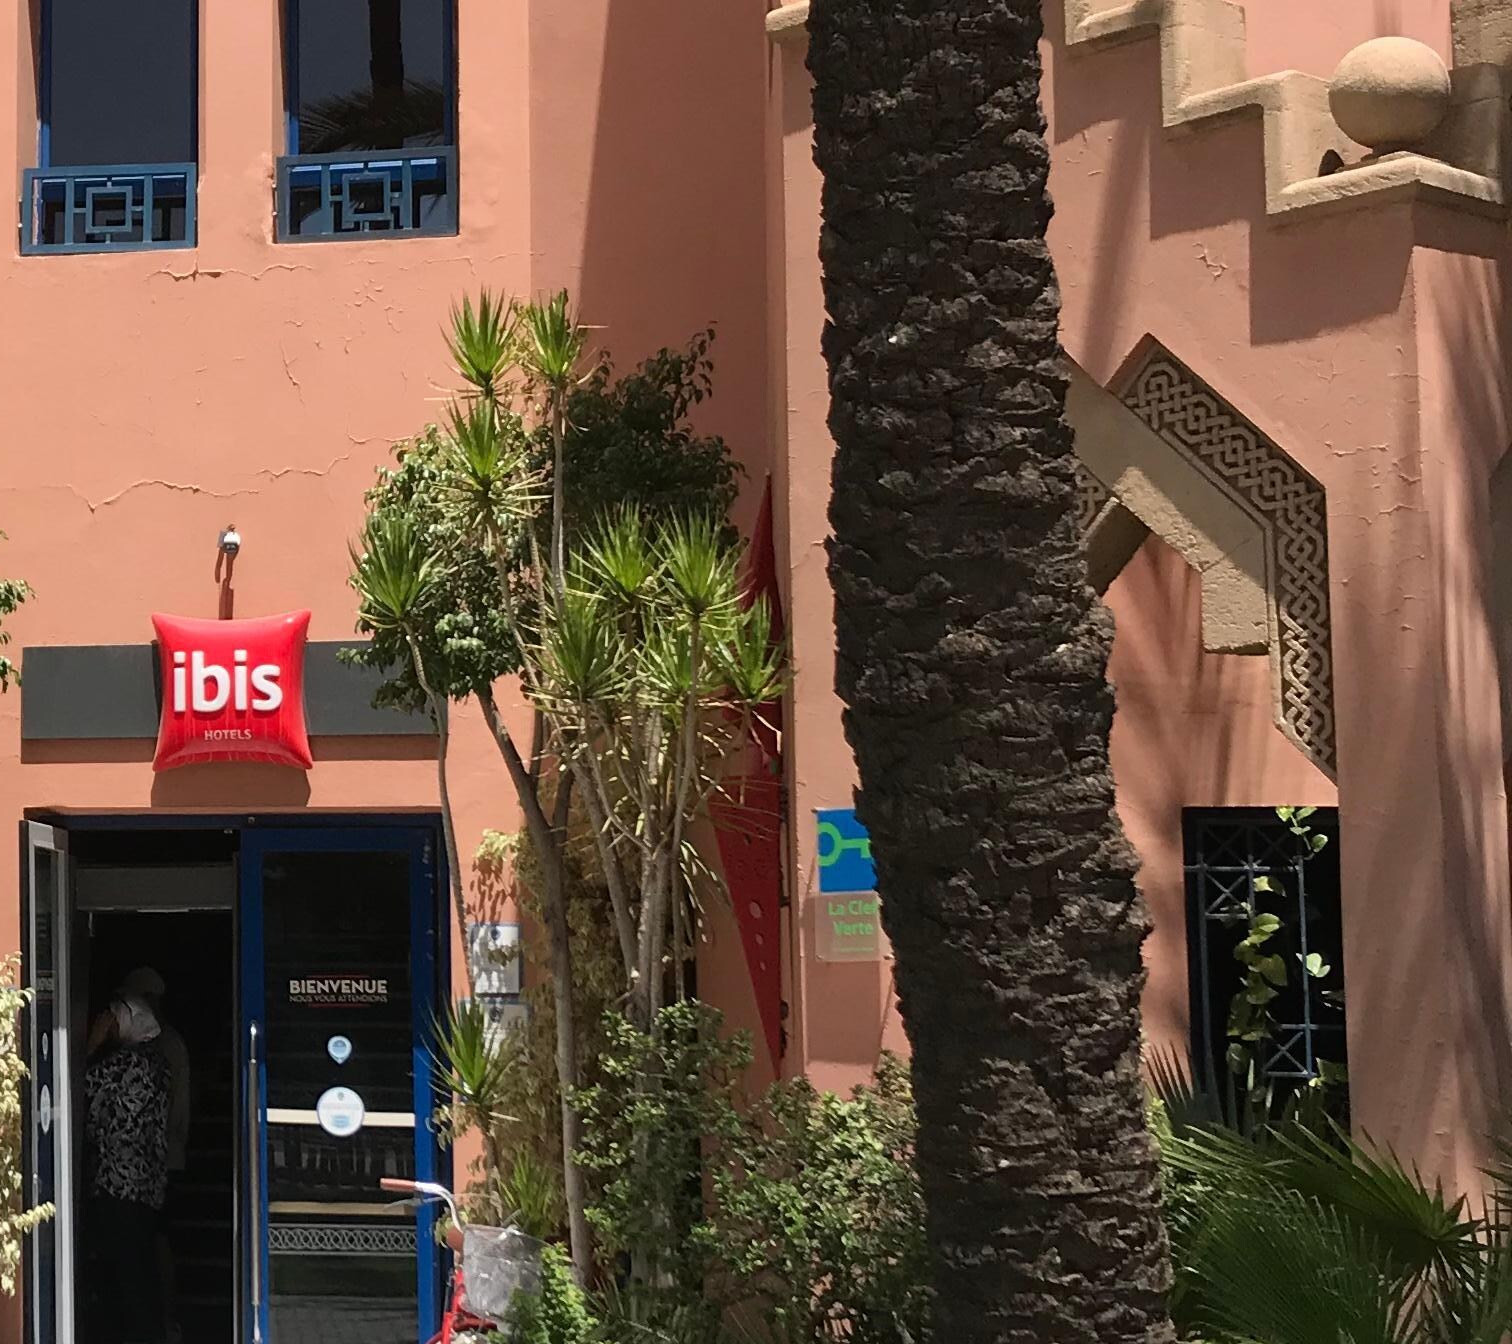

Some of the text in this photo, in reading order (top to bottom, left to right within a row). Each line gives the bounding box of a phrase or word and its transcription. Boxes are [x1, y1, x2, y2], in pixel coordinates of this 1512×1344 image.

[172, 649, 284, 713] ibis
[204, 728, 253, 741] HOTELS
[827, 901, 845, 916] La
[832, 921, 874, 936] Verte
[289, 979, 388, 994] BIENVENUE
[289, 994, 388, 1003] NOUS VOUS ATTENDIONS
